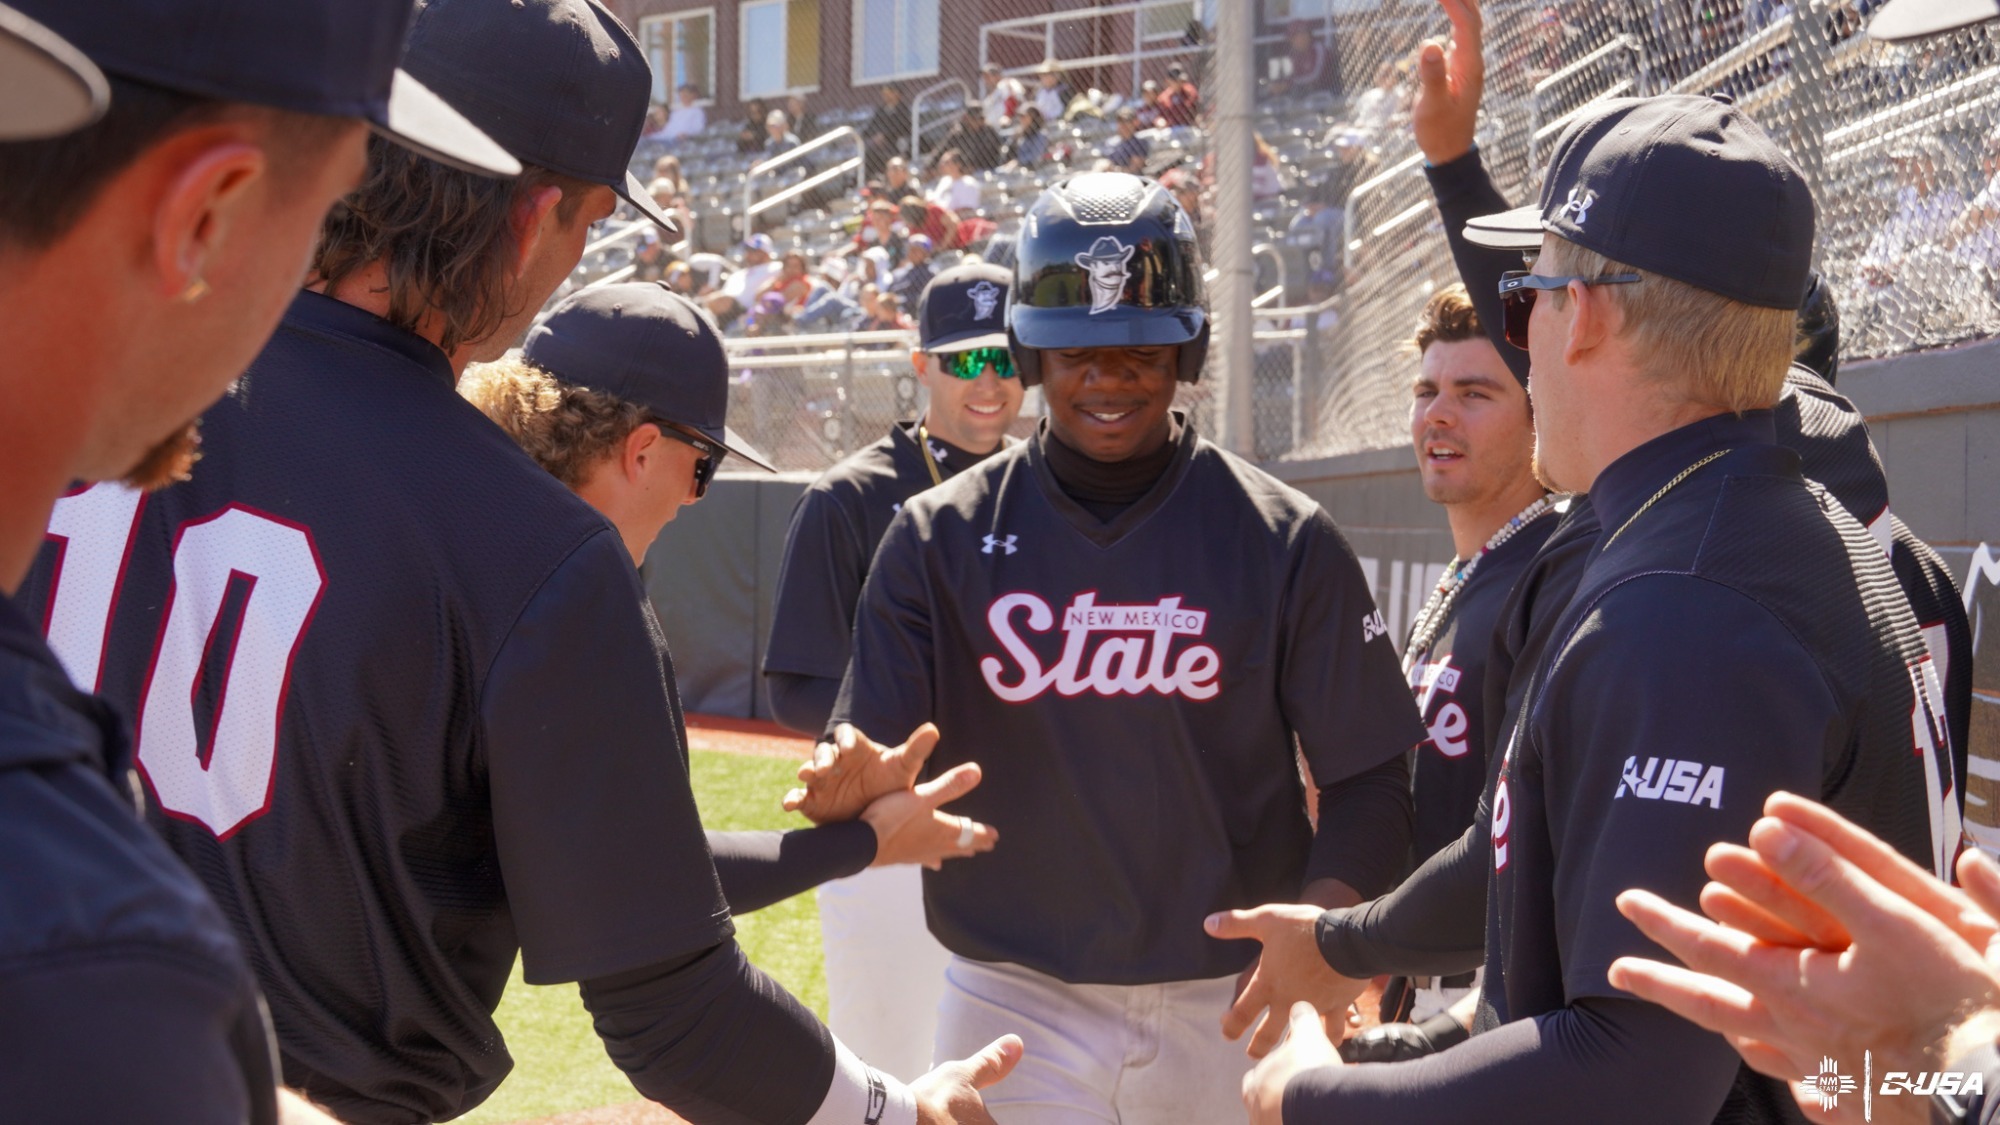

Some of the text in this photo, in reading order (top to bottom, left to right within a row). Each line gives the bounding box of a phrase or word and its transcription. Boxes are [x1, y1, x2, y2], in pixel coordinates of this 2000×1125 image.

[42, 481, 329, 842] 10
[979, 589, 1222, 703] State
[1070, 611, 1199, 630] NEW MEXICO
